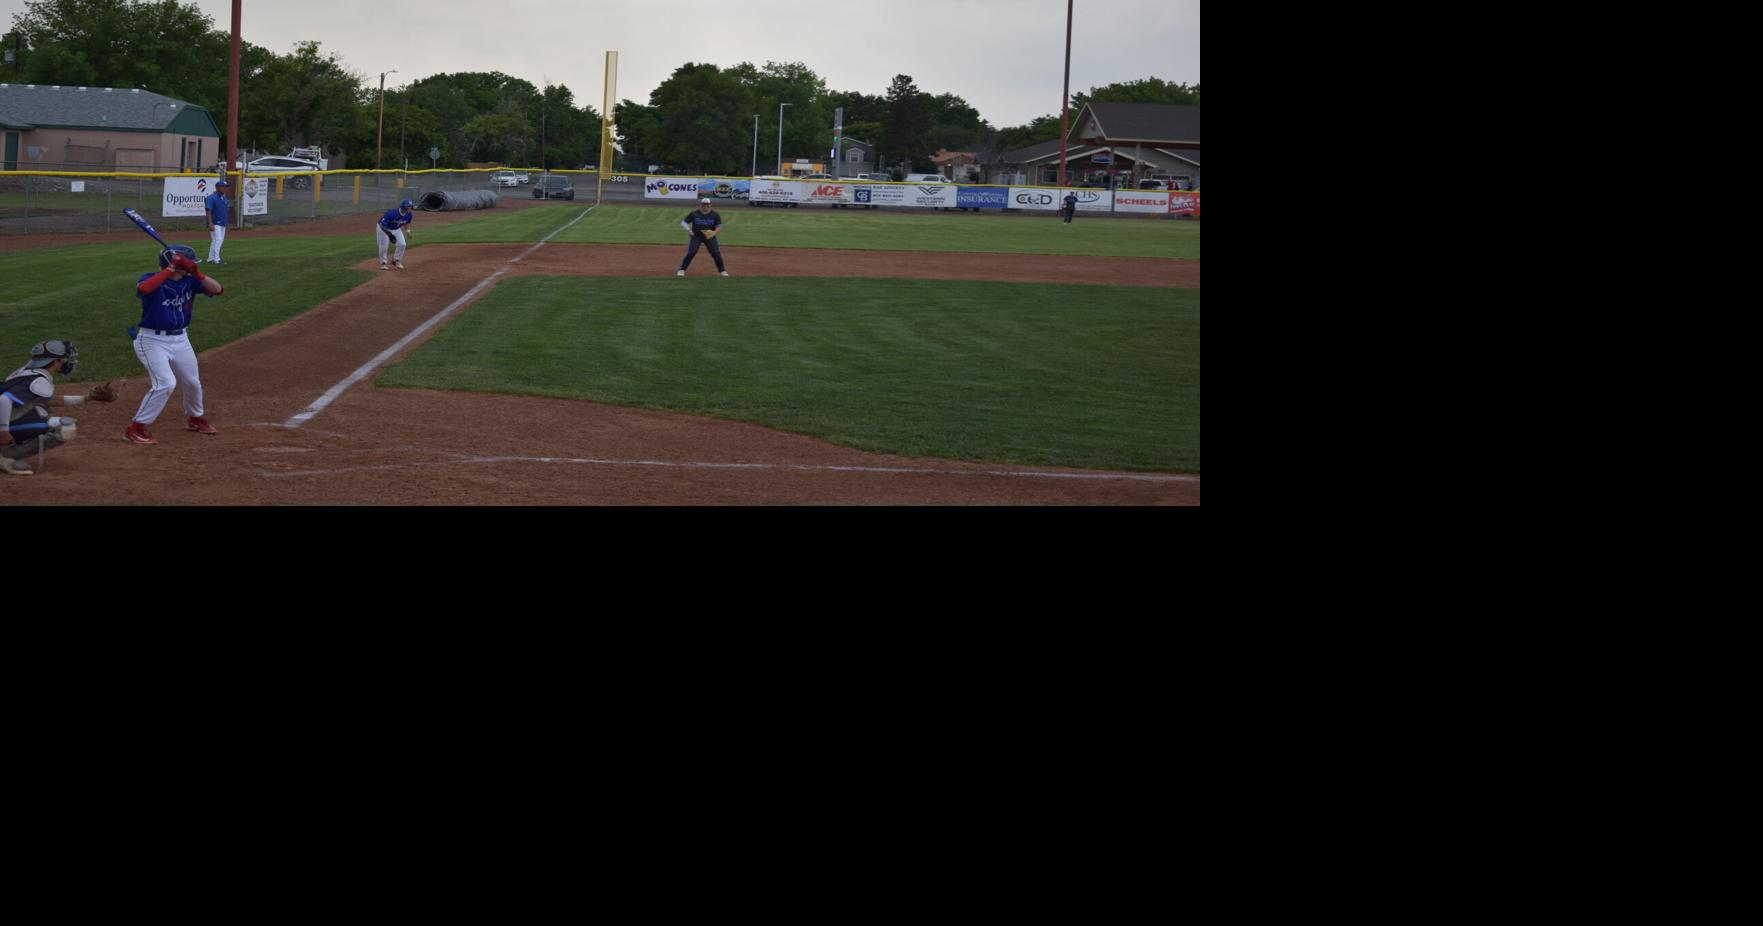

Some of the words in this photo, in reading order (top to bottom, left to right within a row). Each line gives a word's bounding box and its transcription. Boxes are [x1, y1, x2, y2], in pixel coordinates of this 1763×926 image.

[610, 175, 628, 183] 305
[668, 183, 698, 192] CONES
[811, 184, 844, 198] ACE
[958, 196, 1008, 204] INSURANCE
[1116, 198, 1167, 206] SCHEELS
